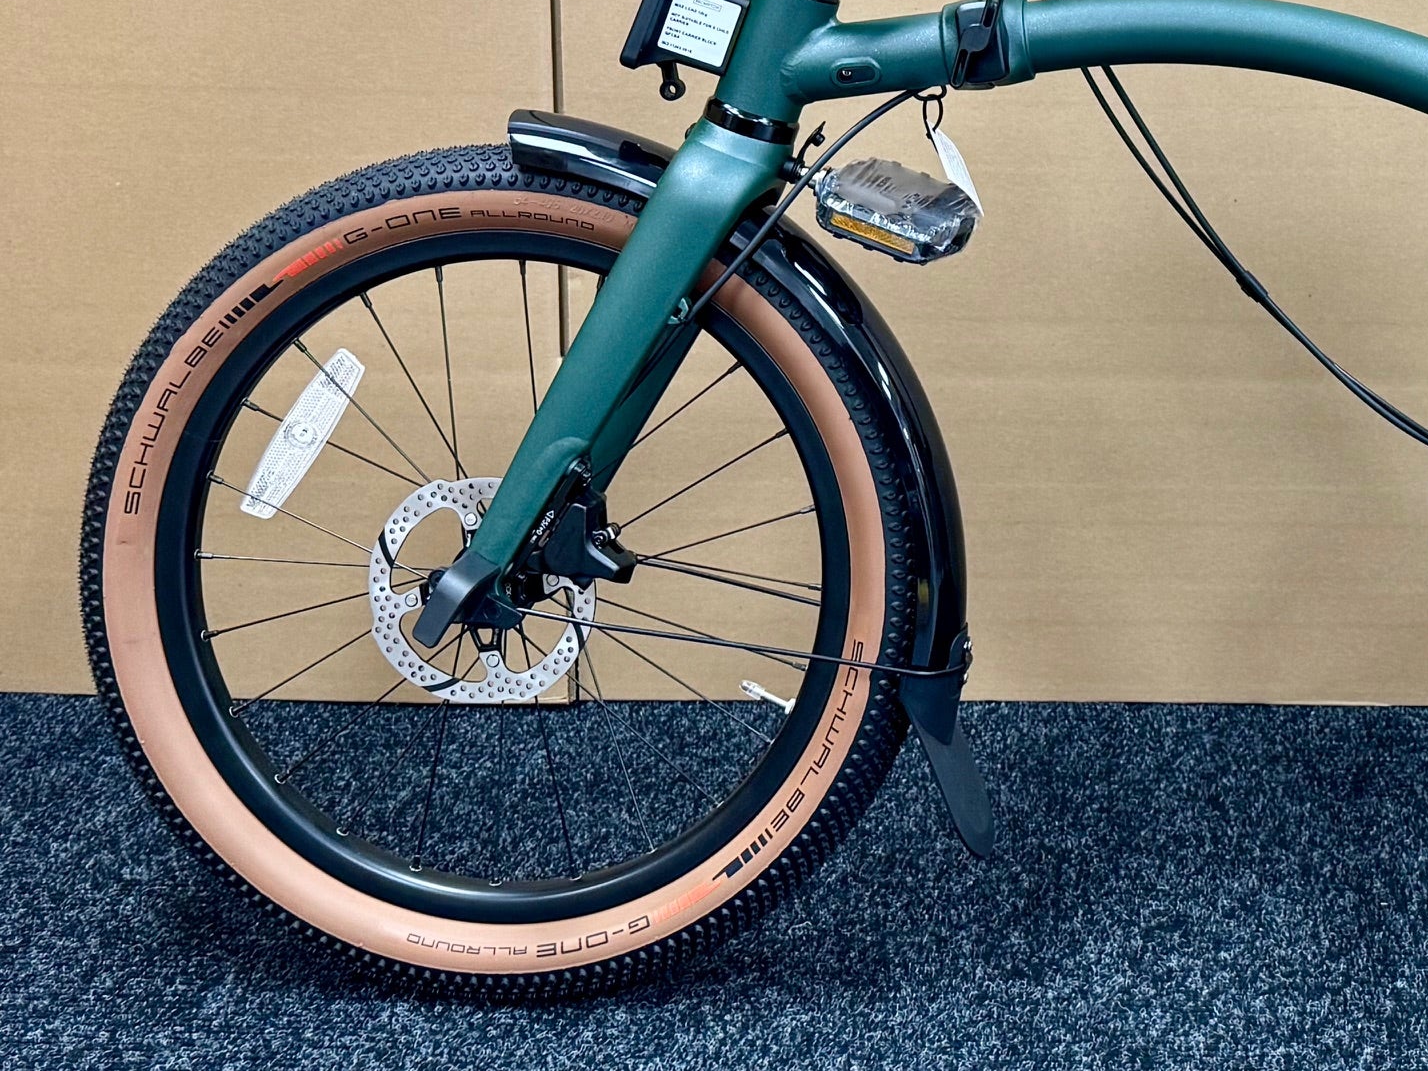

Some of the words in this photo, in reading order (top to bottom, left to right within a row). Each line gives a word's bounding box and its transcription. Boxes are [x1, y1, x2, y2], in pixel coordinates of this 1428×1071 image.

[343, 206, 462, 245] G-ONE
[470, 209, 595, 231] ALLROUND
[124, 327, 224, 515] SCHWALBE
[771, 639, 864, 832] SCHWALBE
[406, 933, 528, 956] ALLROUND
[536, 915, 651, 958] G-ONE
